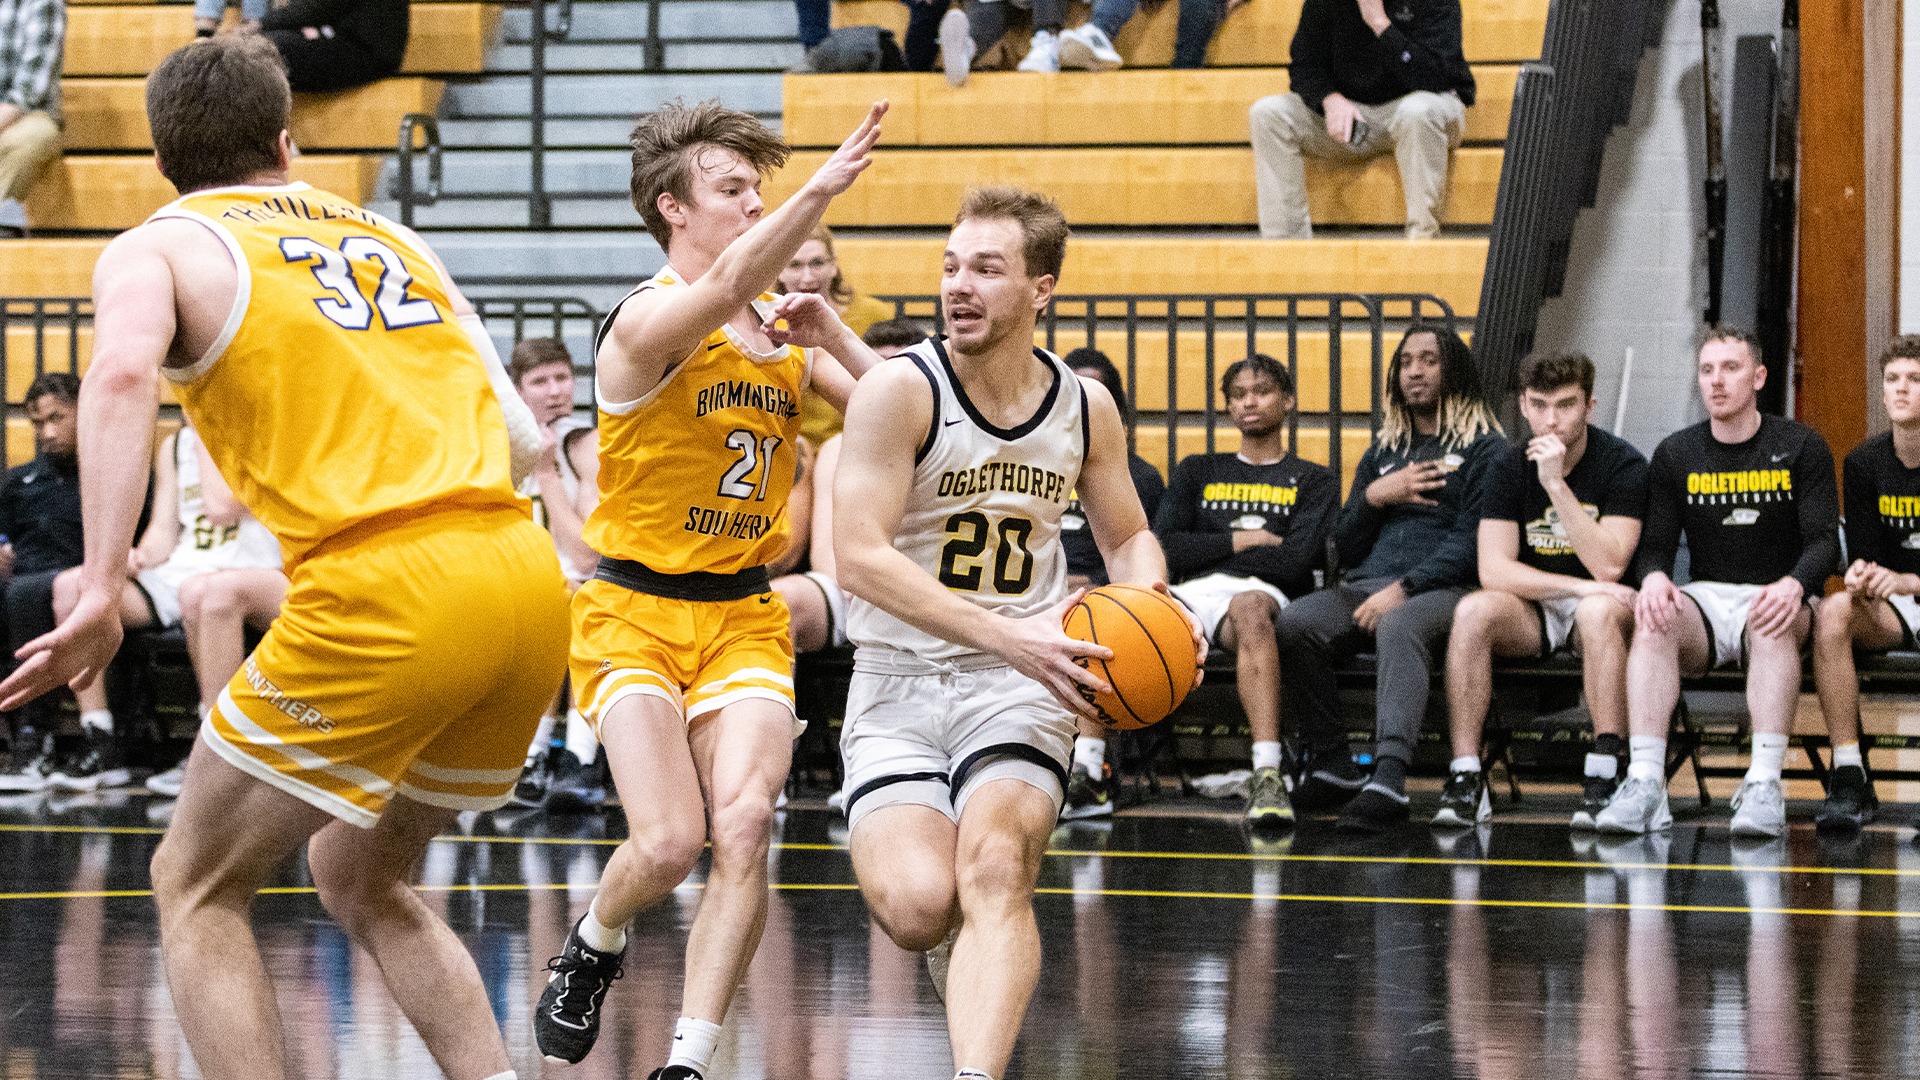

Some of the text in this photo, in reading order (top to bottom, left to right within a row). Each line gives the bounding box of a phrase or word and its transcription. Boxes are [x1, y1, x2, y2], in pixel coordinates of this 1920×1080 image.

[278, 236, 443, 331] 32
[695, 380, 799, 421] BIRMINGH
[717, 429, 783, 501] 21
[937, 462, 1065, 503] OGLETHORPE
[1687, 469, 1791, 494] OGLETHORPE
[938, 511, 1034, 595] 20
